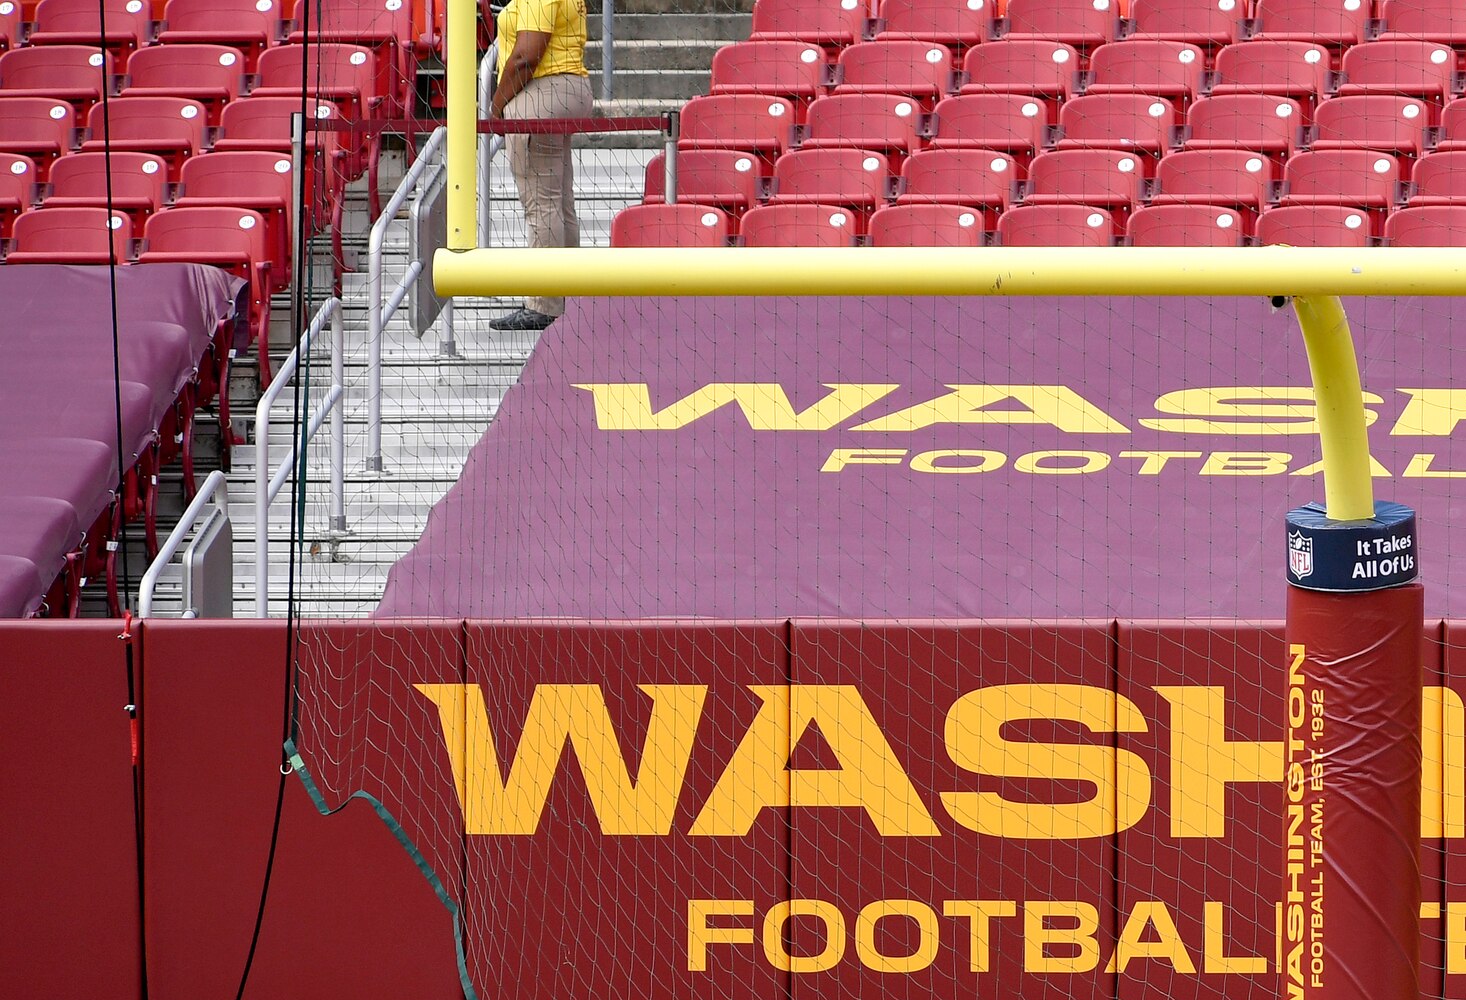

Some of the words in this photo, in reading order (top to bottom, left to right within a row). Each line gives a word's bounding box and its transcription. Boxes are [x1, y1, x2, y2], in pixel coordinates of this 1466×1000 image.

[1352, 559, 1377, 579] All
[1379, 557, 1399, 577] Of
[1400, 553, 1414, 571] Us
[1357, 540, 1370, 556] It
[1372, 535, 1412, 555] Takes
[1311, 689, 1325, 741] 1932
[1310, 748, 1325, 791] EST.
[1310, 798, 1326, 868] TEAM,
[687, 899, 1284, 975] FOOTBAL
[1310, 871, 1325, 988] FOOTBALL
